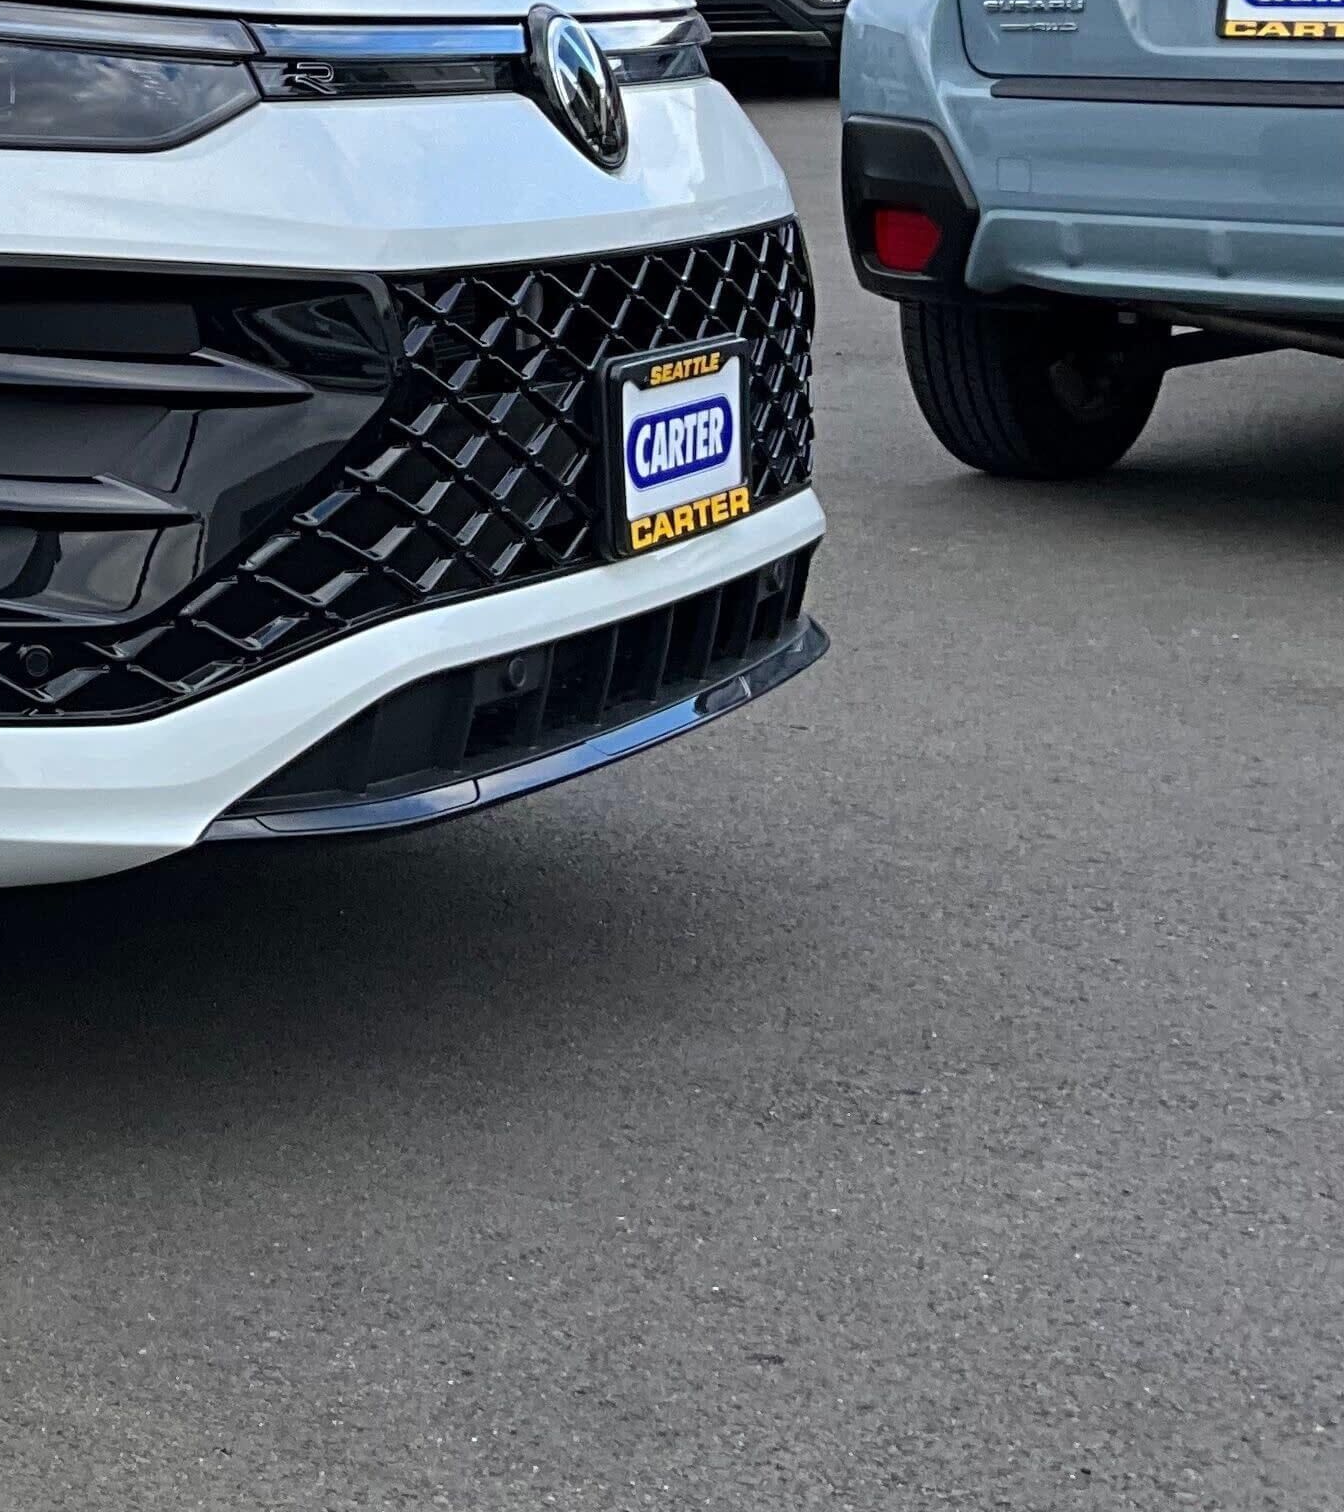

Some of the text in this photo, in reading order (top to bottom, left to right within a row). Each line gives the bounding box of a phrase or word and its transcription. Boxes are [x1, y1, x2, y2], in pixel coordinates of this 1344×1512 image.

[649, 352, 720, 386] SEATTLE
[634, 406, 725, 478] CARTER
[630, 487, 751, 551] CARTER
